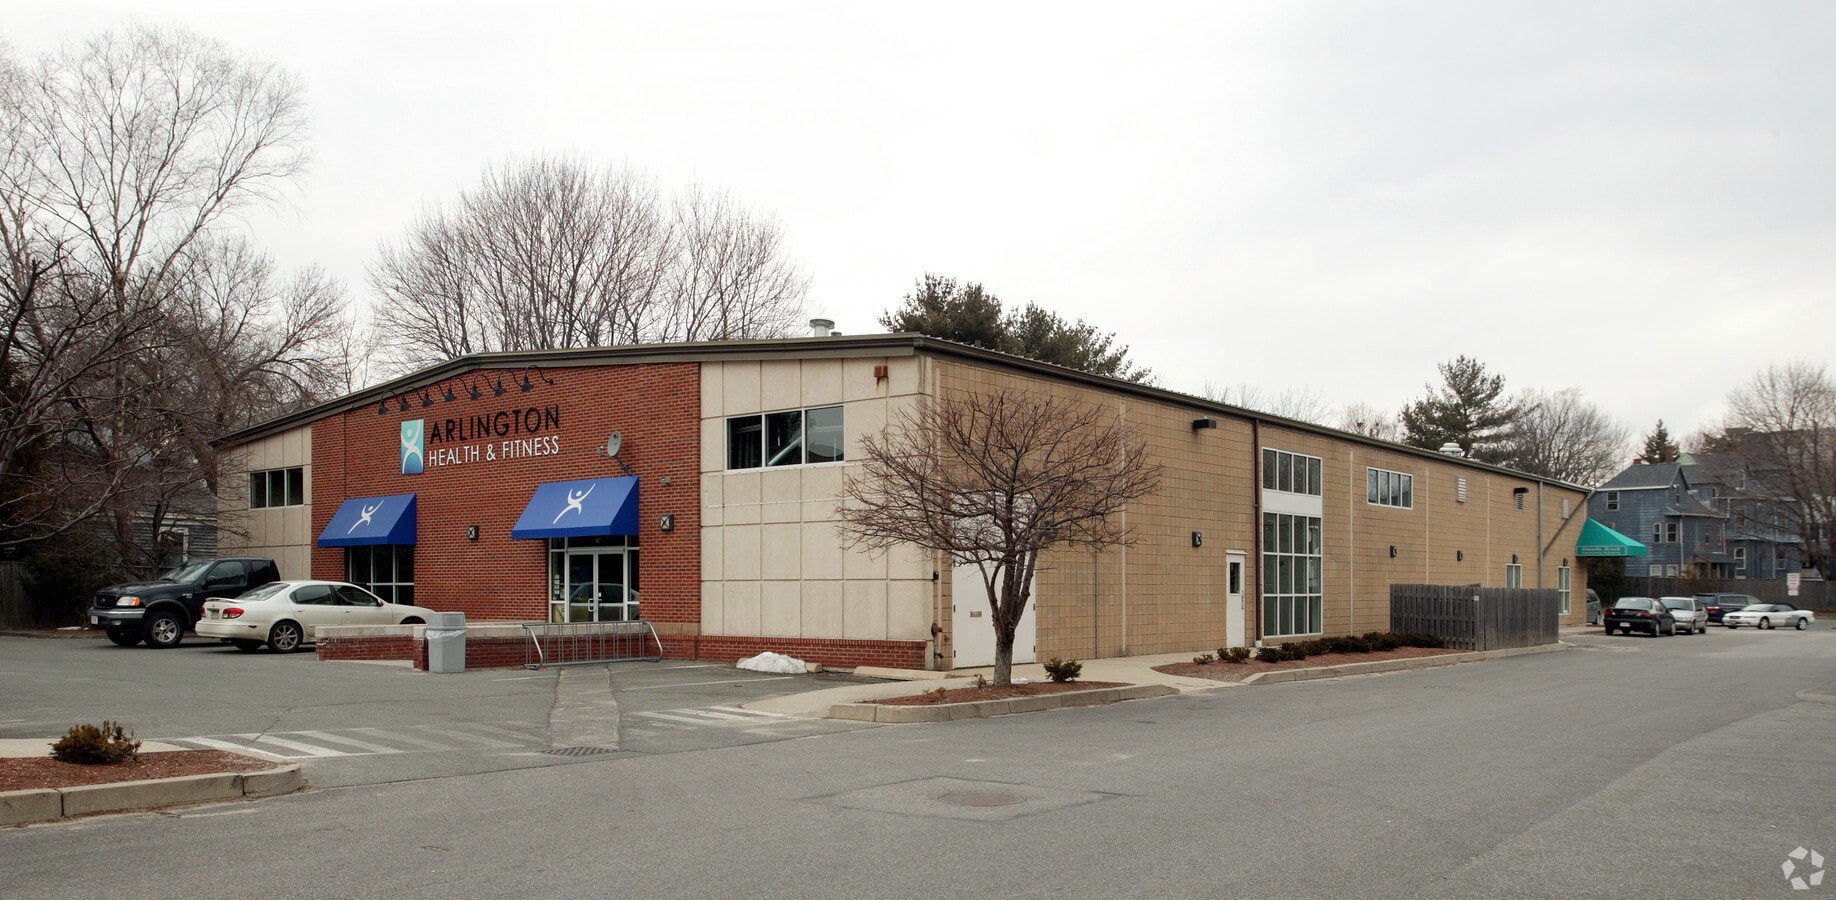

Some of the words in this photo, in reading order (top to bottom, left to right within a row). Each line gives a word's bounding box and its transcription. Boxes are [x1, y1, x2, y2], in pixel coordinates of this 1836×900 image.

[430, 404, 559, 444] ARLINGTON
[429, 444, 480, 467] HEALTH
[486, 444, 497, 461] &
[502, 435, 559, 459] FITNESS
